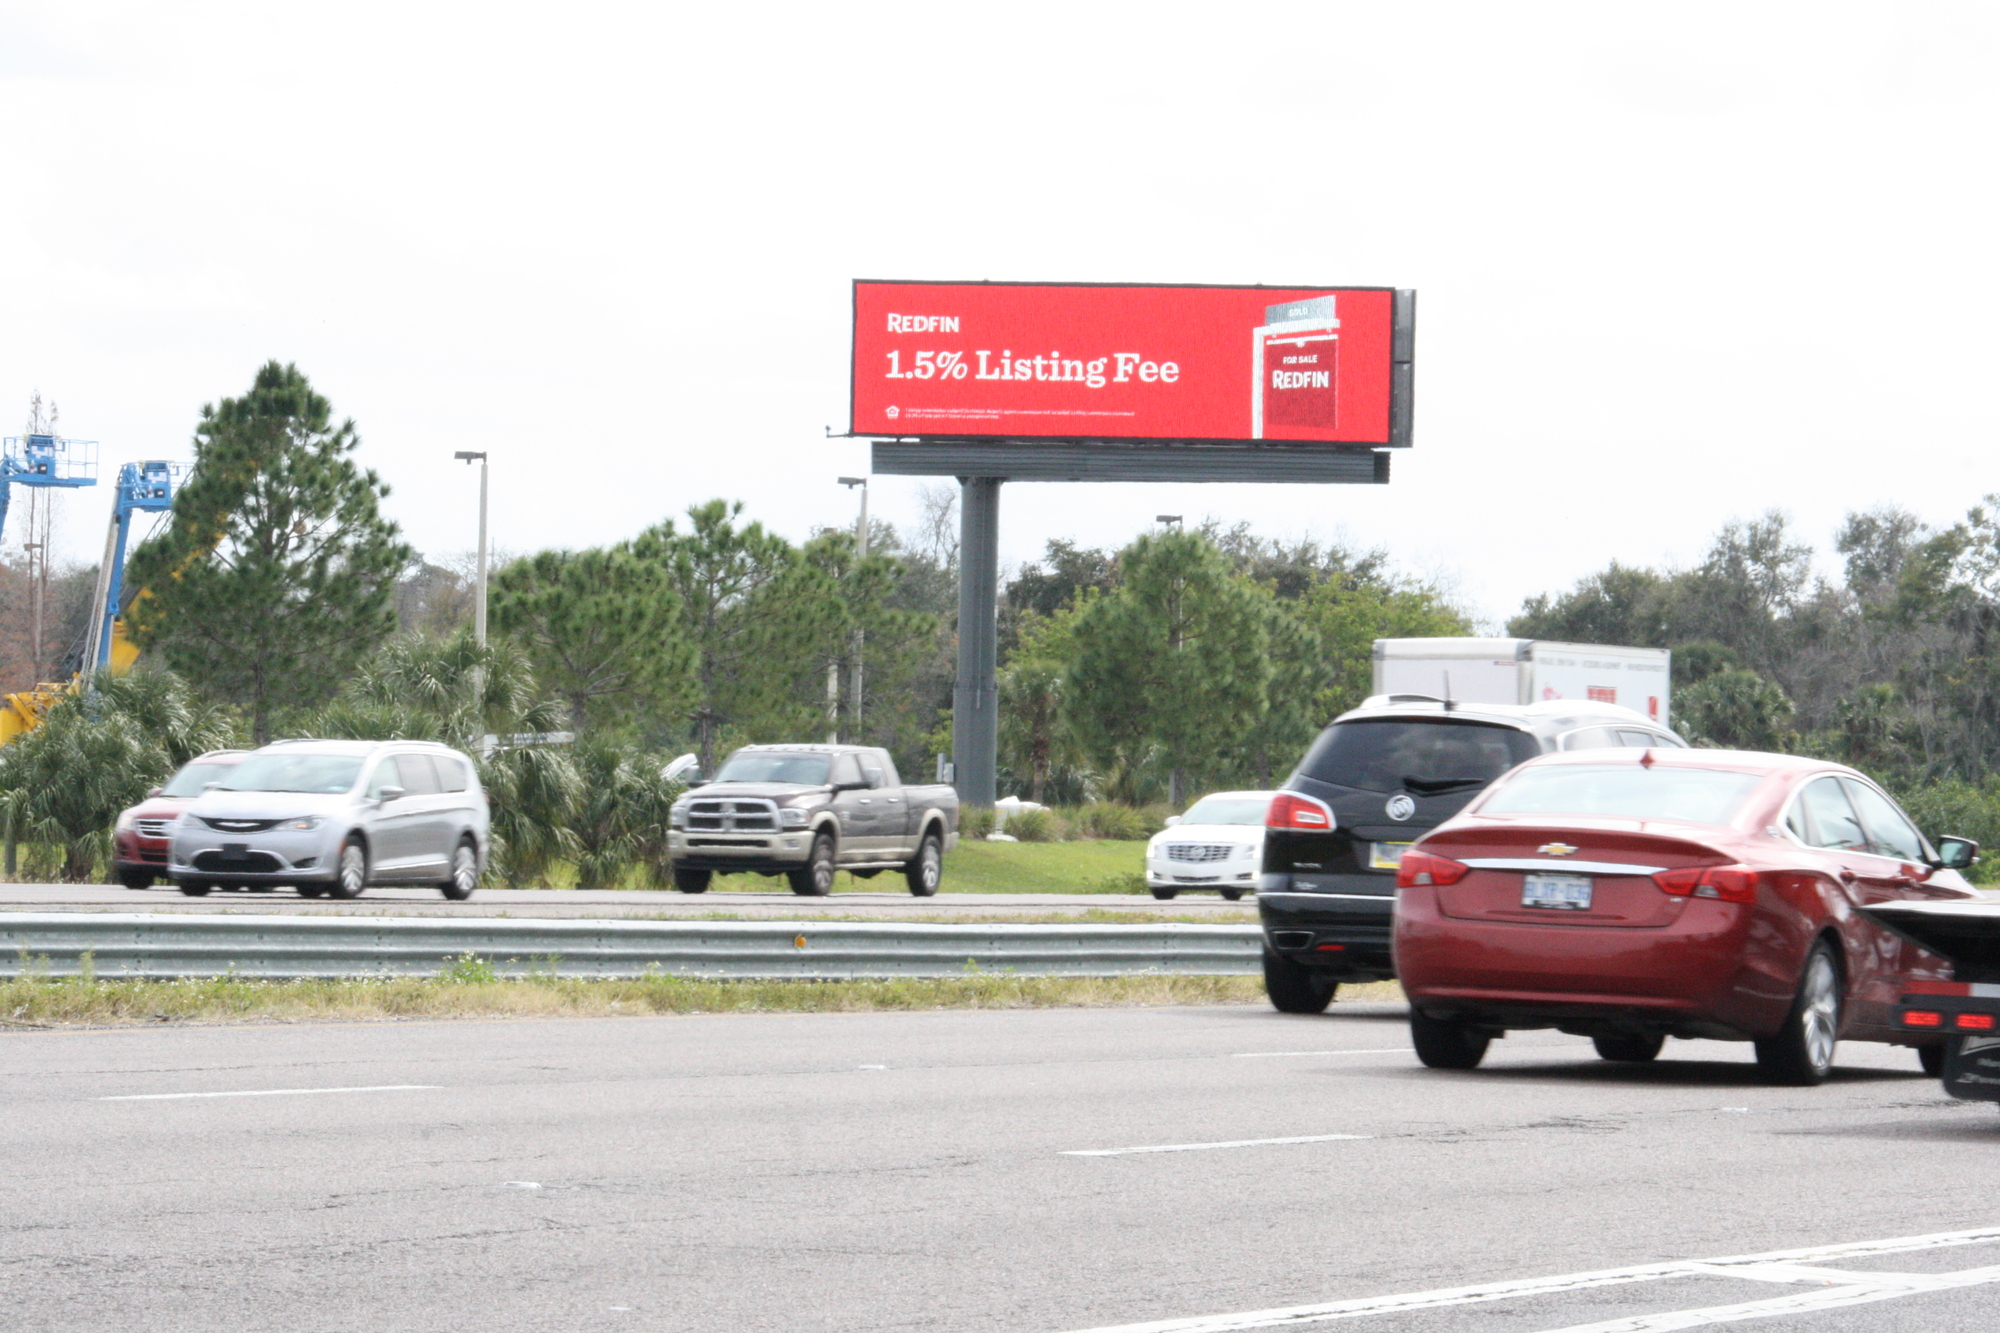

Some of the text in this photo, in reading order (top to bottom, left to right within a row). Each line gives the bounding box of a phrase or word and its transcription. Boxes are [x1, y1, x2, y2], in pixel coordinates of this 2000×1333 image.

[887, 312, 960, 333] REDFIN
[885, 349, 1180, 389] 1.5% Listing Fee
[1282, 354, 1318, 365] FOR SALE
[1272, 369, 1329, 390] REDFIN
